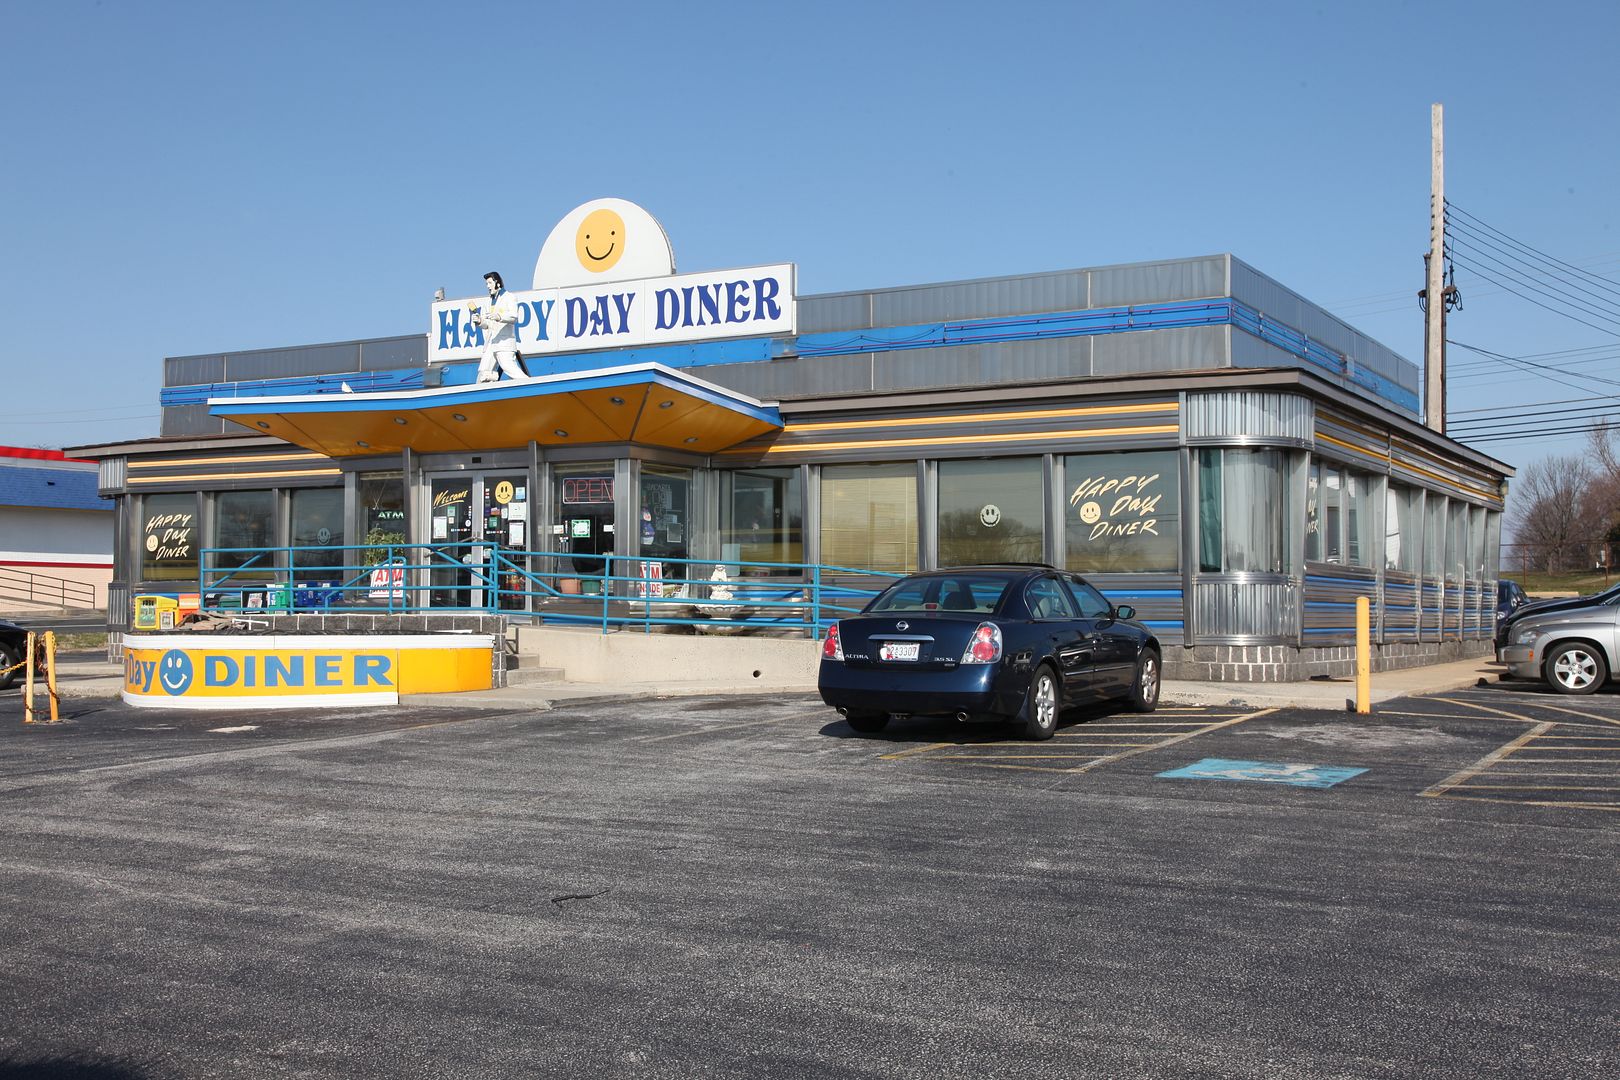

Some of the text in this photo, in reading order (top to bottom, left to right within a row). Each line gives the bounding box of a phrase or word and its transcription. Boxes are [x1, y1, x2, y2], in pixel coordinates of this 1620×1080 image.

[438, 277, 781, 350] HAPY DAY DINER
[565, 480, 614, 502] OPEN
[1070, 474, 1160, 506] HAPPY
[146, 514, 193, 534] HAPPY
[378, 511, 404, 519] ATM
[1088, 519, 1158, 541] DINER
[155, 545, 190, 560] DINER
[129, 654, 156, 692] Day
[204, 655, 393, 687] DINER
